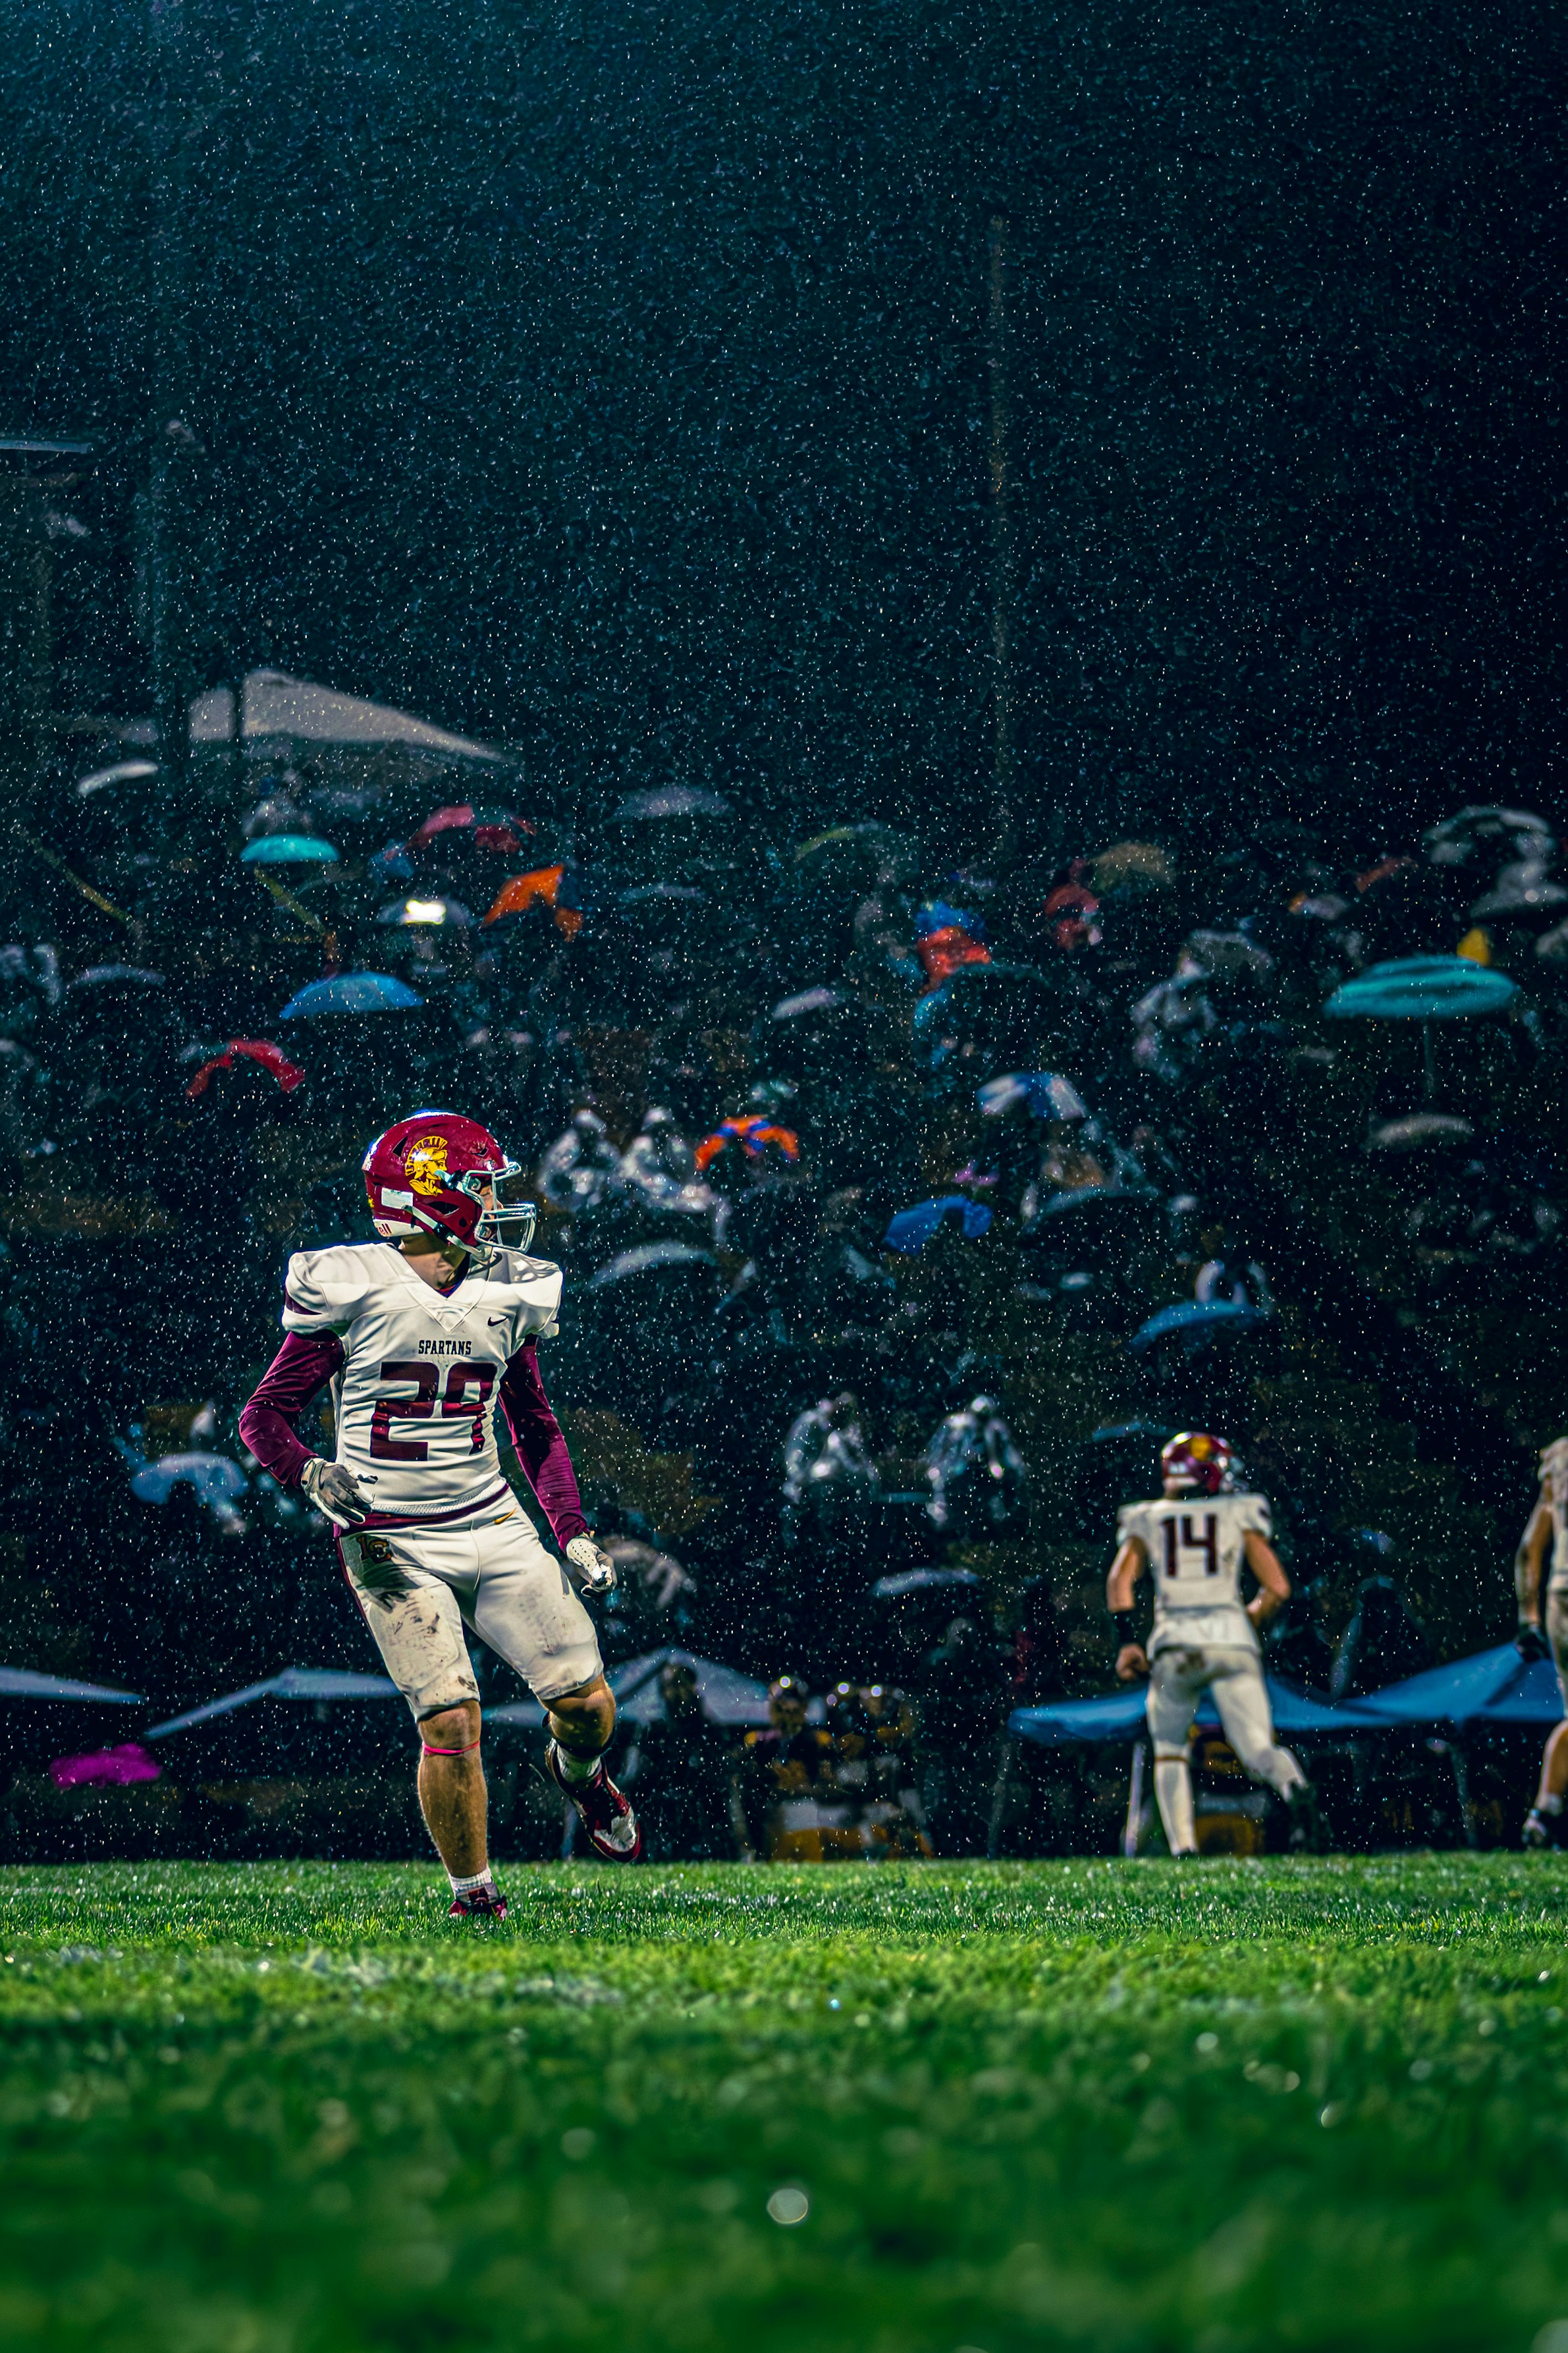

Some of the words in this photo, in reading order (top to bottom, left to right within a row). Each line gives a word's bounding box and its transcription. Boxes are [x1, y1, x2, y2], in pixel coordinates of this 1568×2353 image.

[418, 1340, 472, 1355] SPARTANS
[370, 1362, 497, 1461] 29
[1160, 1514, 1217, 1578] 14
